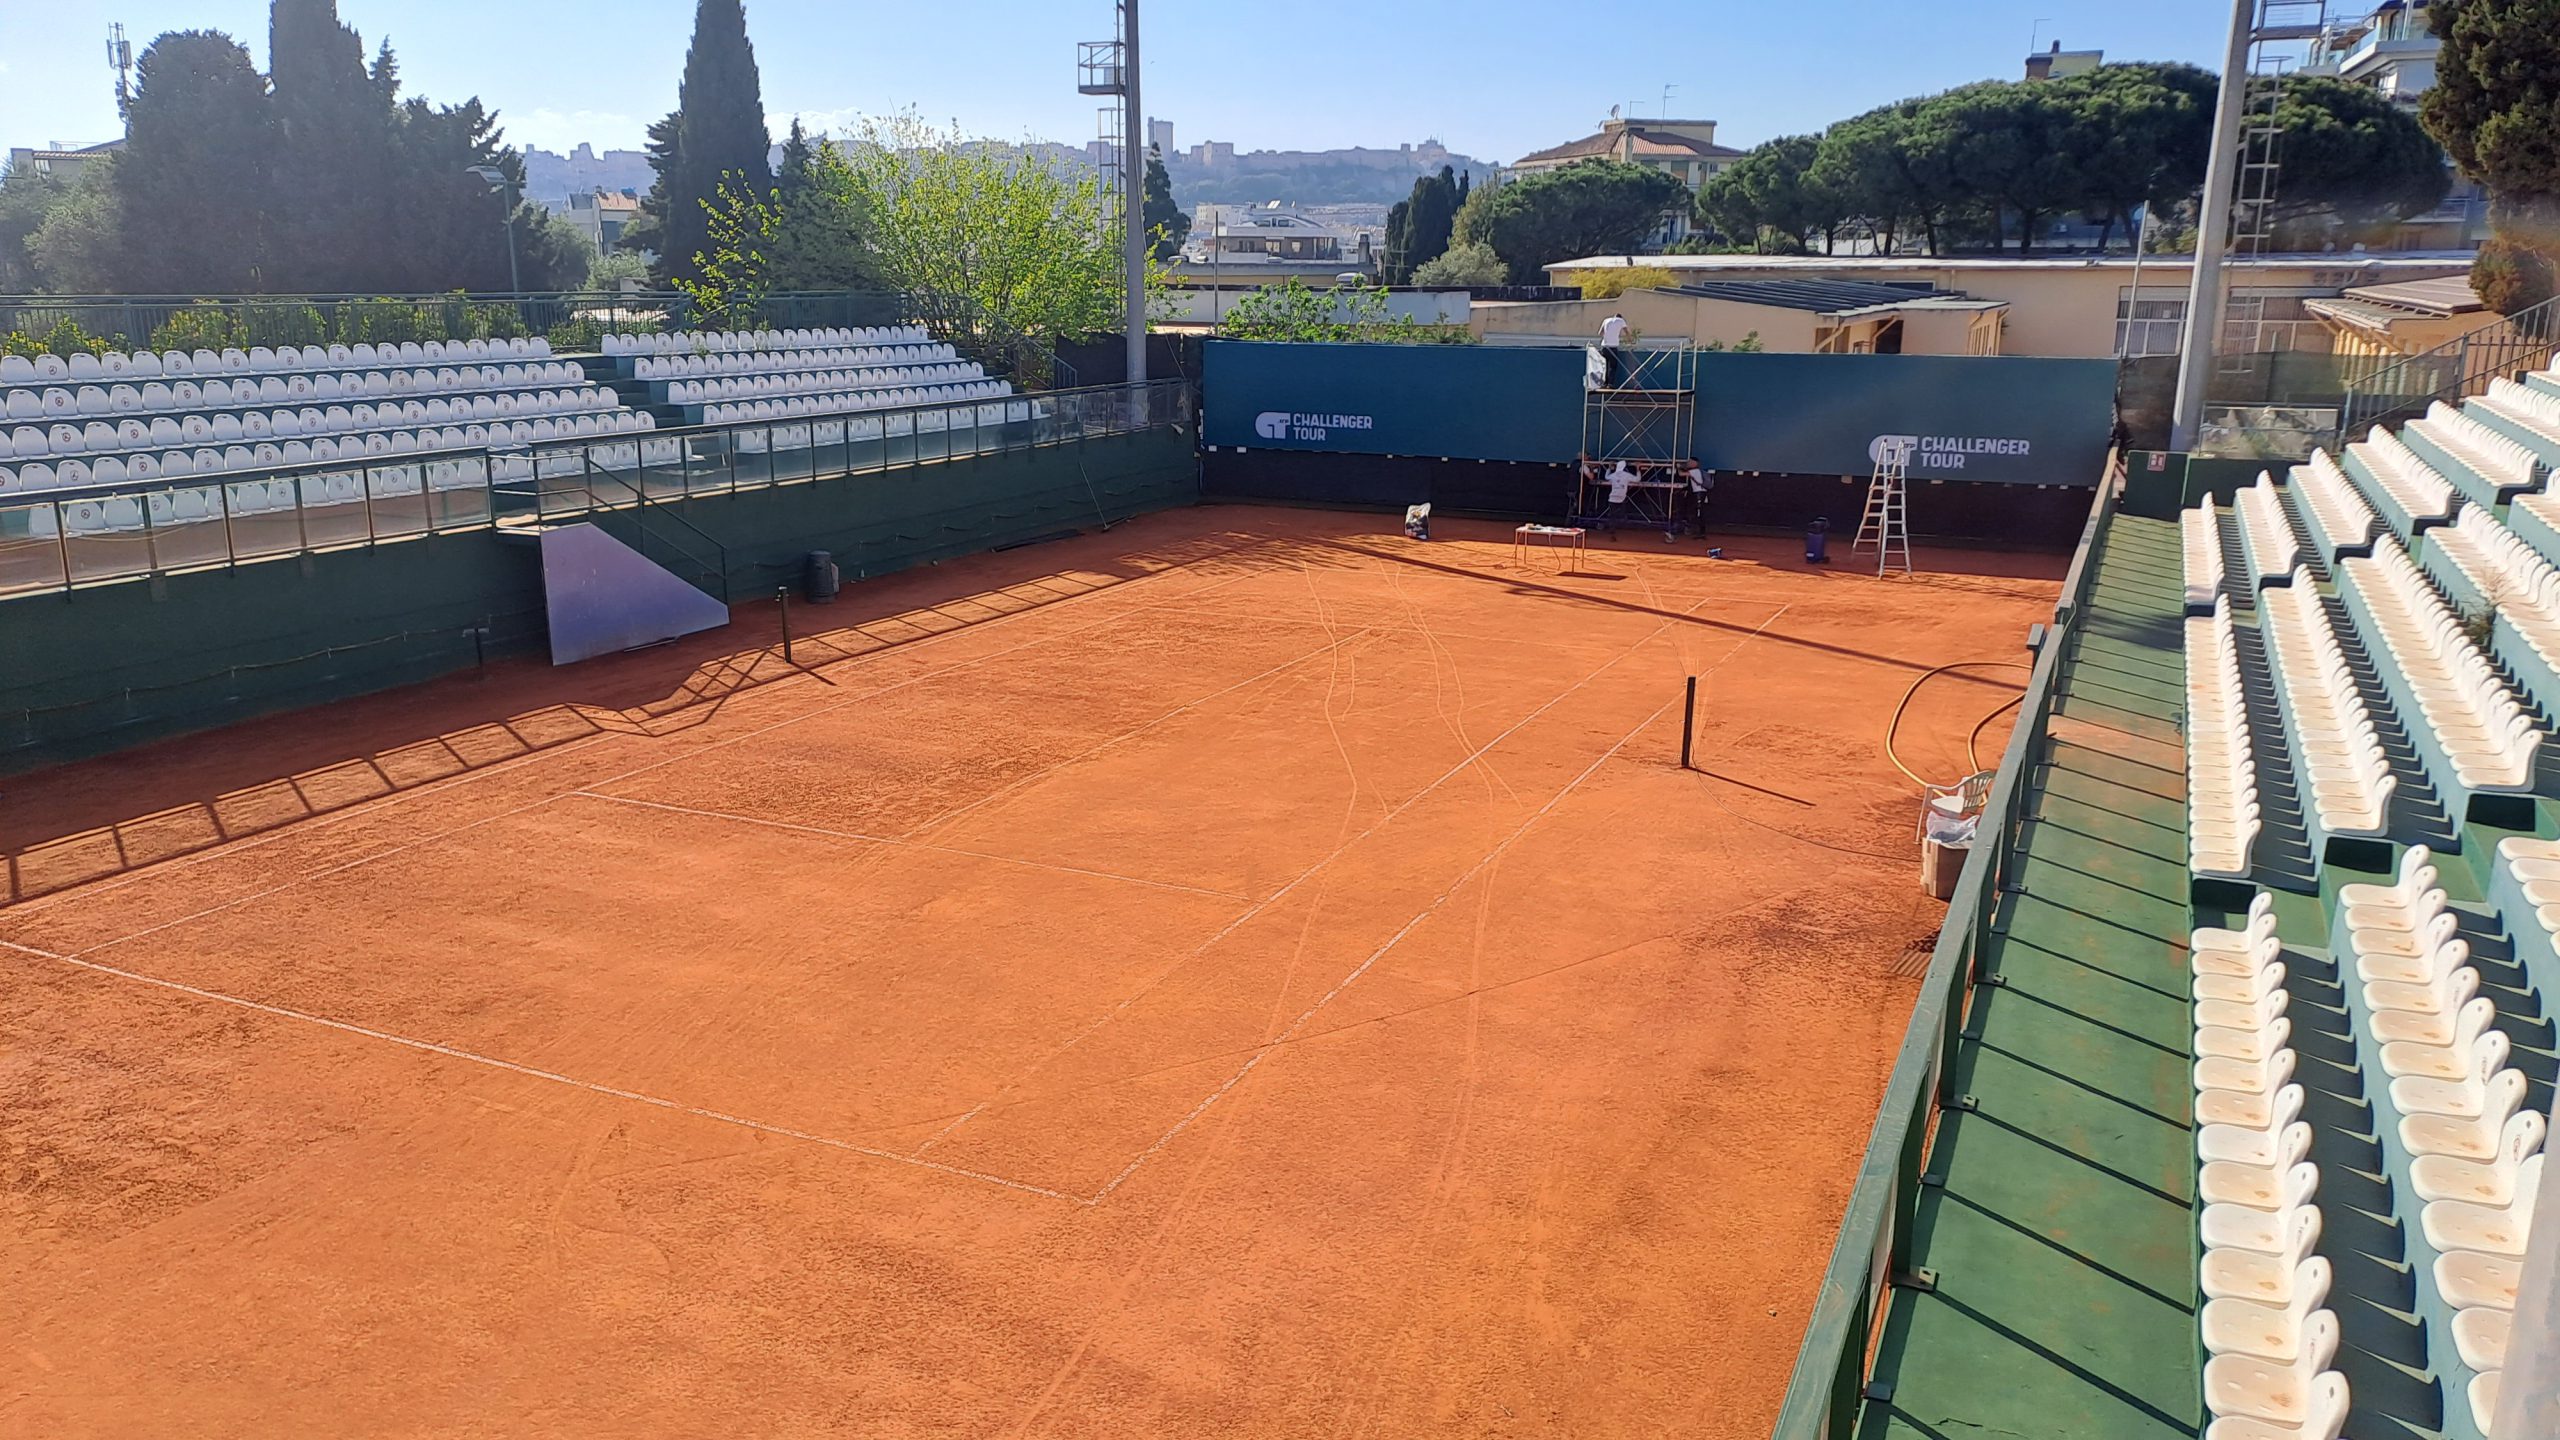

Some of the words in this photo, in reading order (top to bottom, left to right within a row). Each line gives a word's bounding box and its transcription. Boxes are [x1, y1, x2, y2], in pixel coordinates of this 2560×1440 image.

[1293, 413, 1373, 429] CHALLENGER
[1293, 427, 1326, 441] TOUR
[1921, 436, 2030, 455] CHALLENGER
[1920, 452, 1965, 469] TOUR
